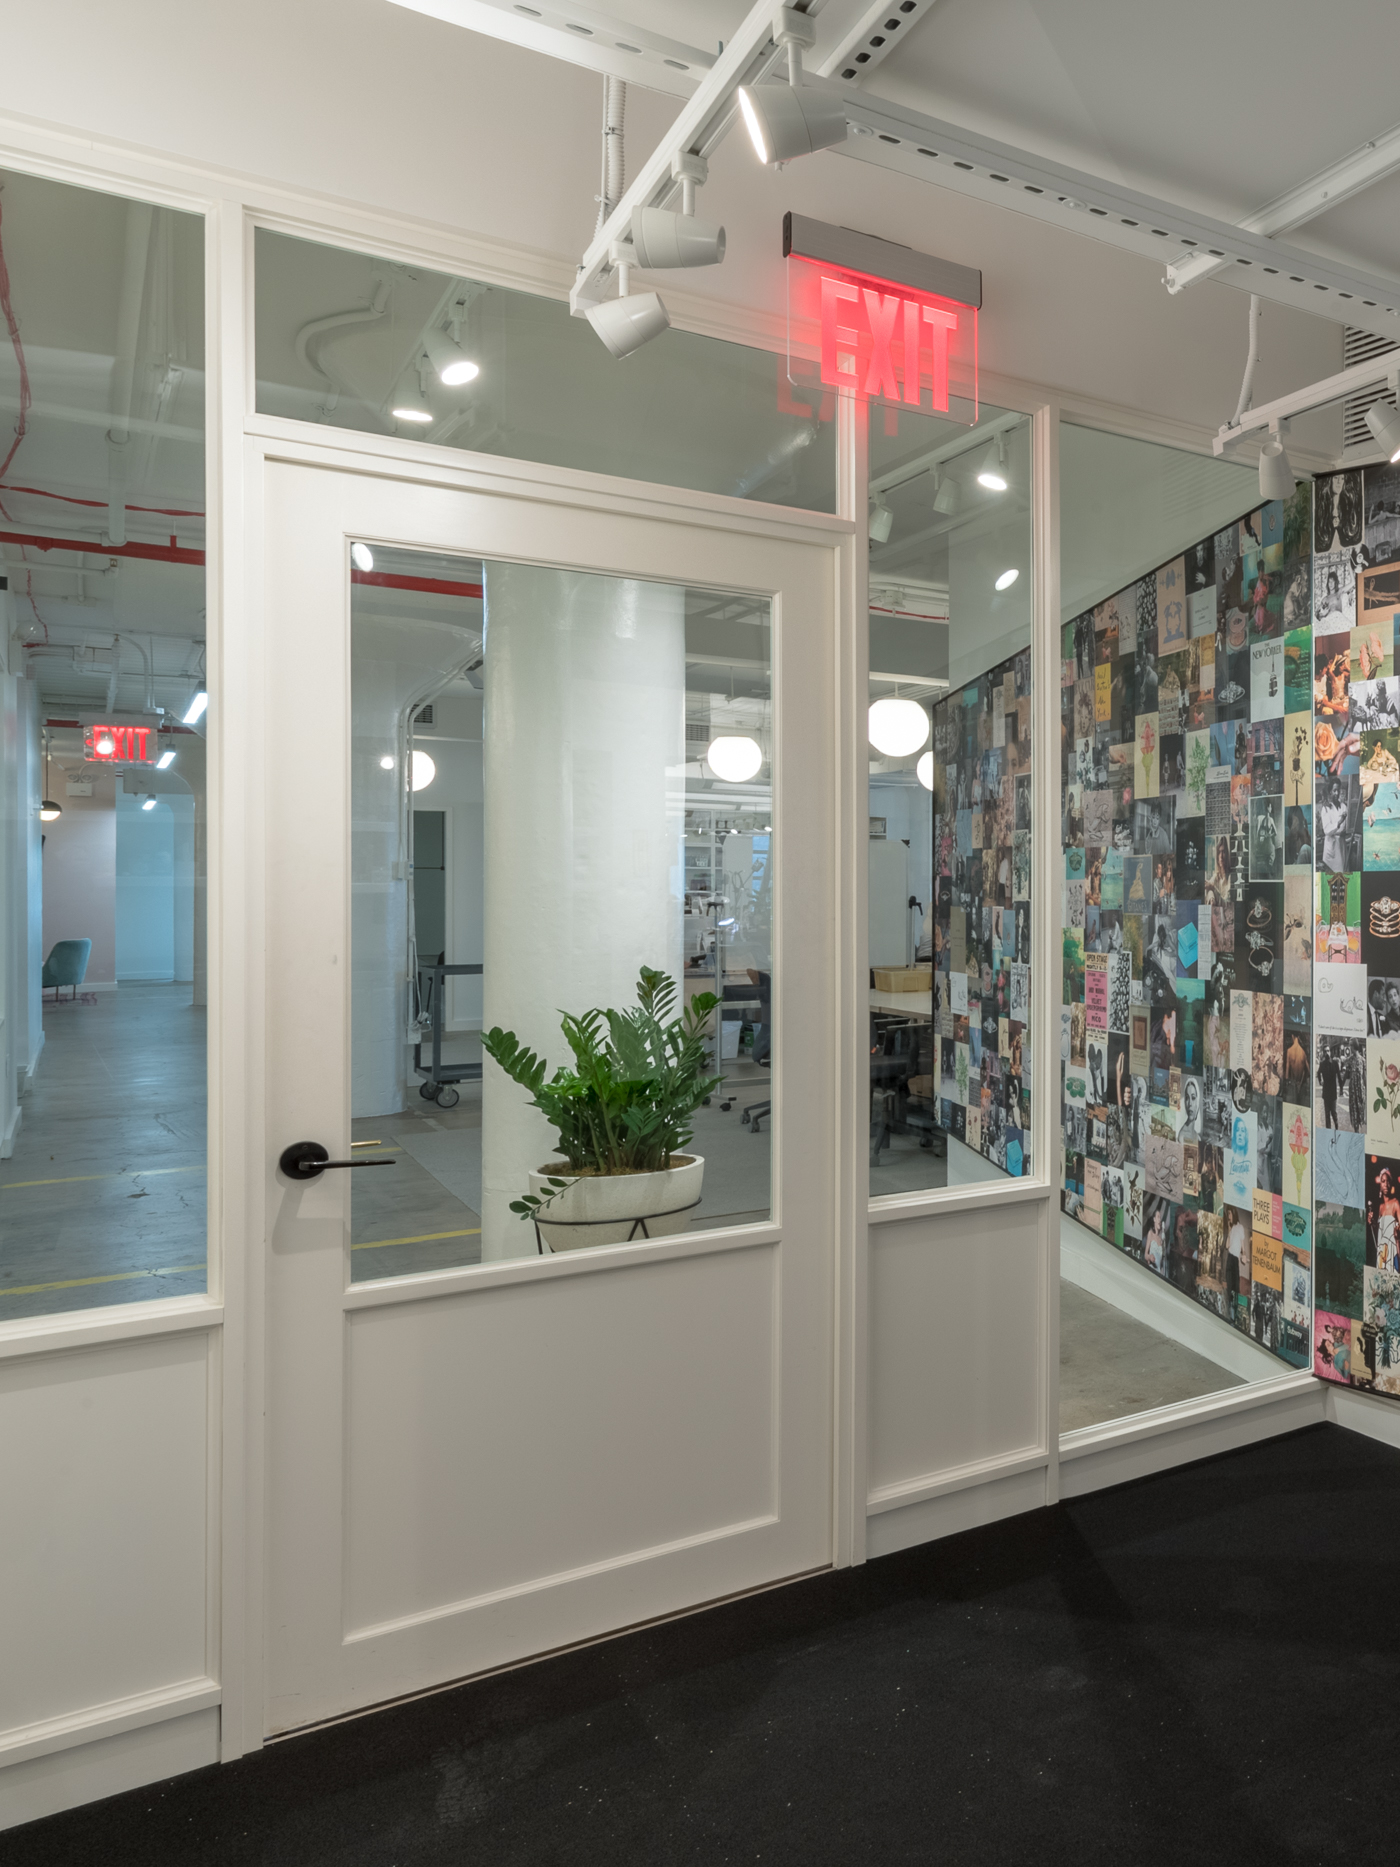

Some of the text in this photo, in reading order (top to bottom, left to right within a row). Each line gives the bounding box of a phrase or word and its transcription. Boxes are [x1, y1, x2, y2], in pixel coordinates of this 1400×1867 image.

[820, 276, 958, 412] EXIT
[1252, 645, 1282, 660] NEW YORKER
[93, 725, 151, 760] EXIT
[1253, 1197, 1270, 1214] THREE
[1254, 1212, 1270, 1225] PLAYS
[1256, 1247, 1277, 1261] MARGOT
[1253, 1254, 1281, 1274] TENENBAUM
